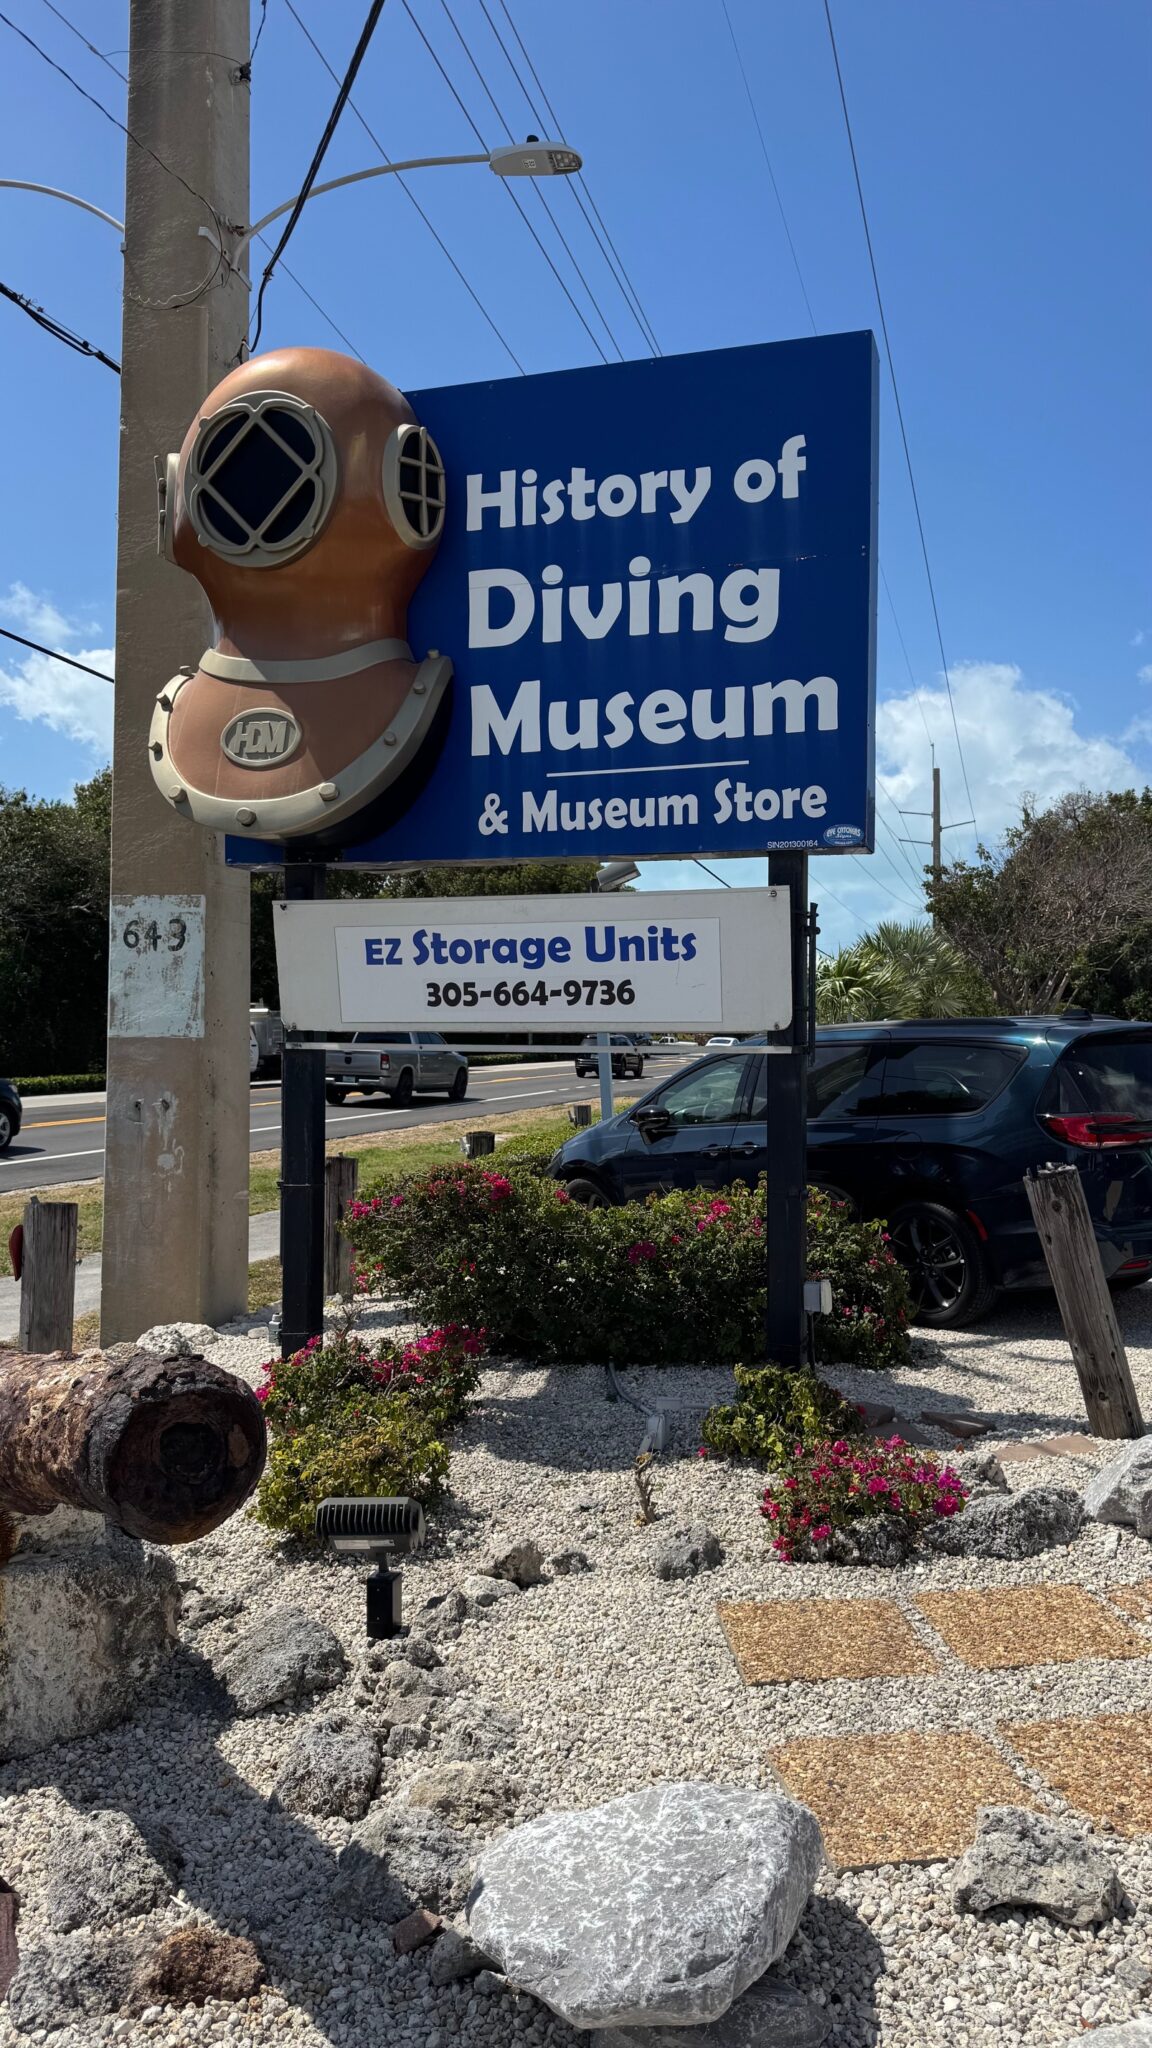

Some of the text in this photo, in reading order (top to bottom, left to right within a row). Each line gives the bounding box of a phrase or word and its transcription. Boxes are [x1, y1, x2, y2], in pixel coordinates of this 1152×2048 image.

[467, 434, 807, 531] History of
[468, 555, 780, 649] Diving
[230, 720, 288, 753] HDM
[470, 675, 838, 757] Museum
[478, 778, 828, 836] & Museum Store
[365, 925, 697, 970] EZ Storage Units
[426, 979, 636, 1008] 305-664-9736
